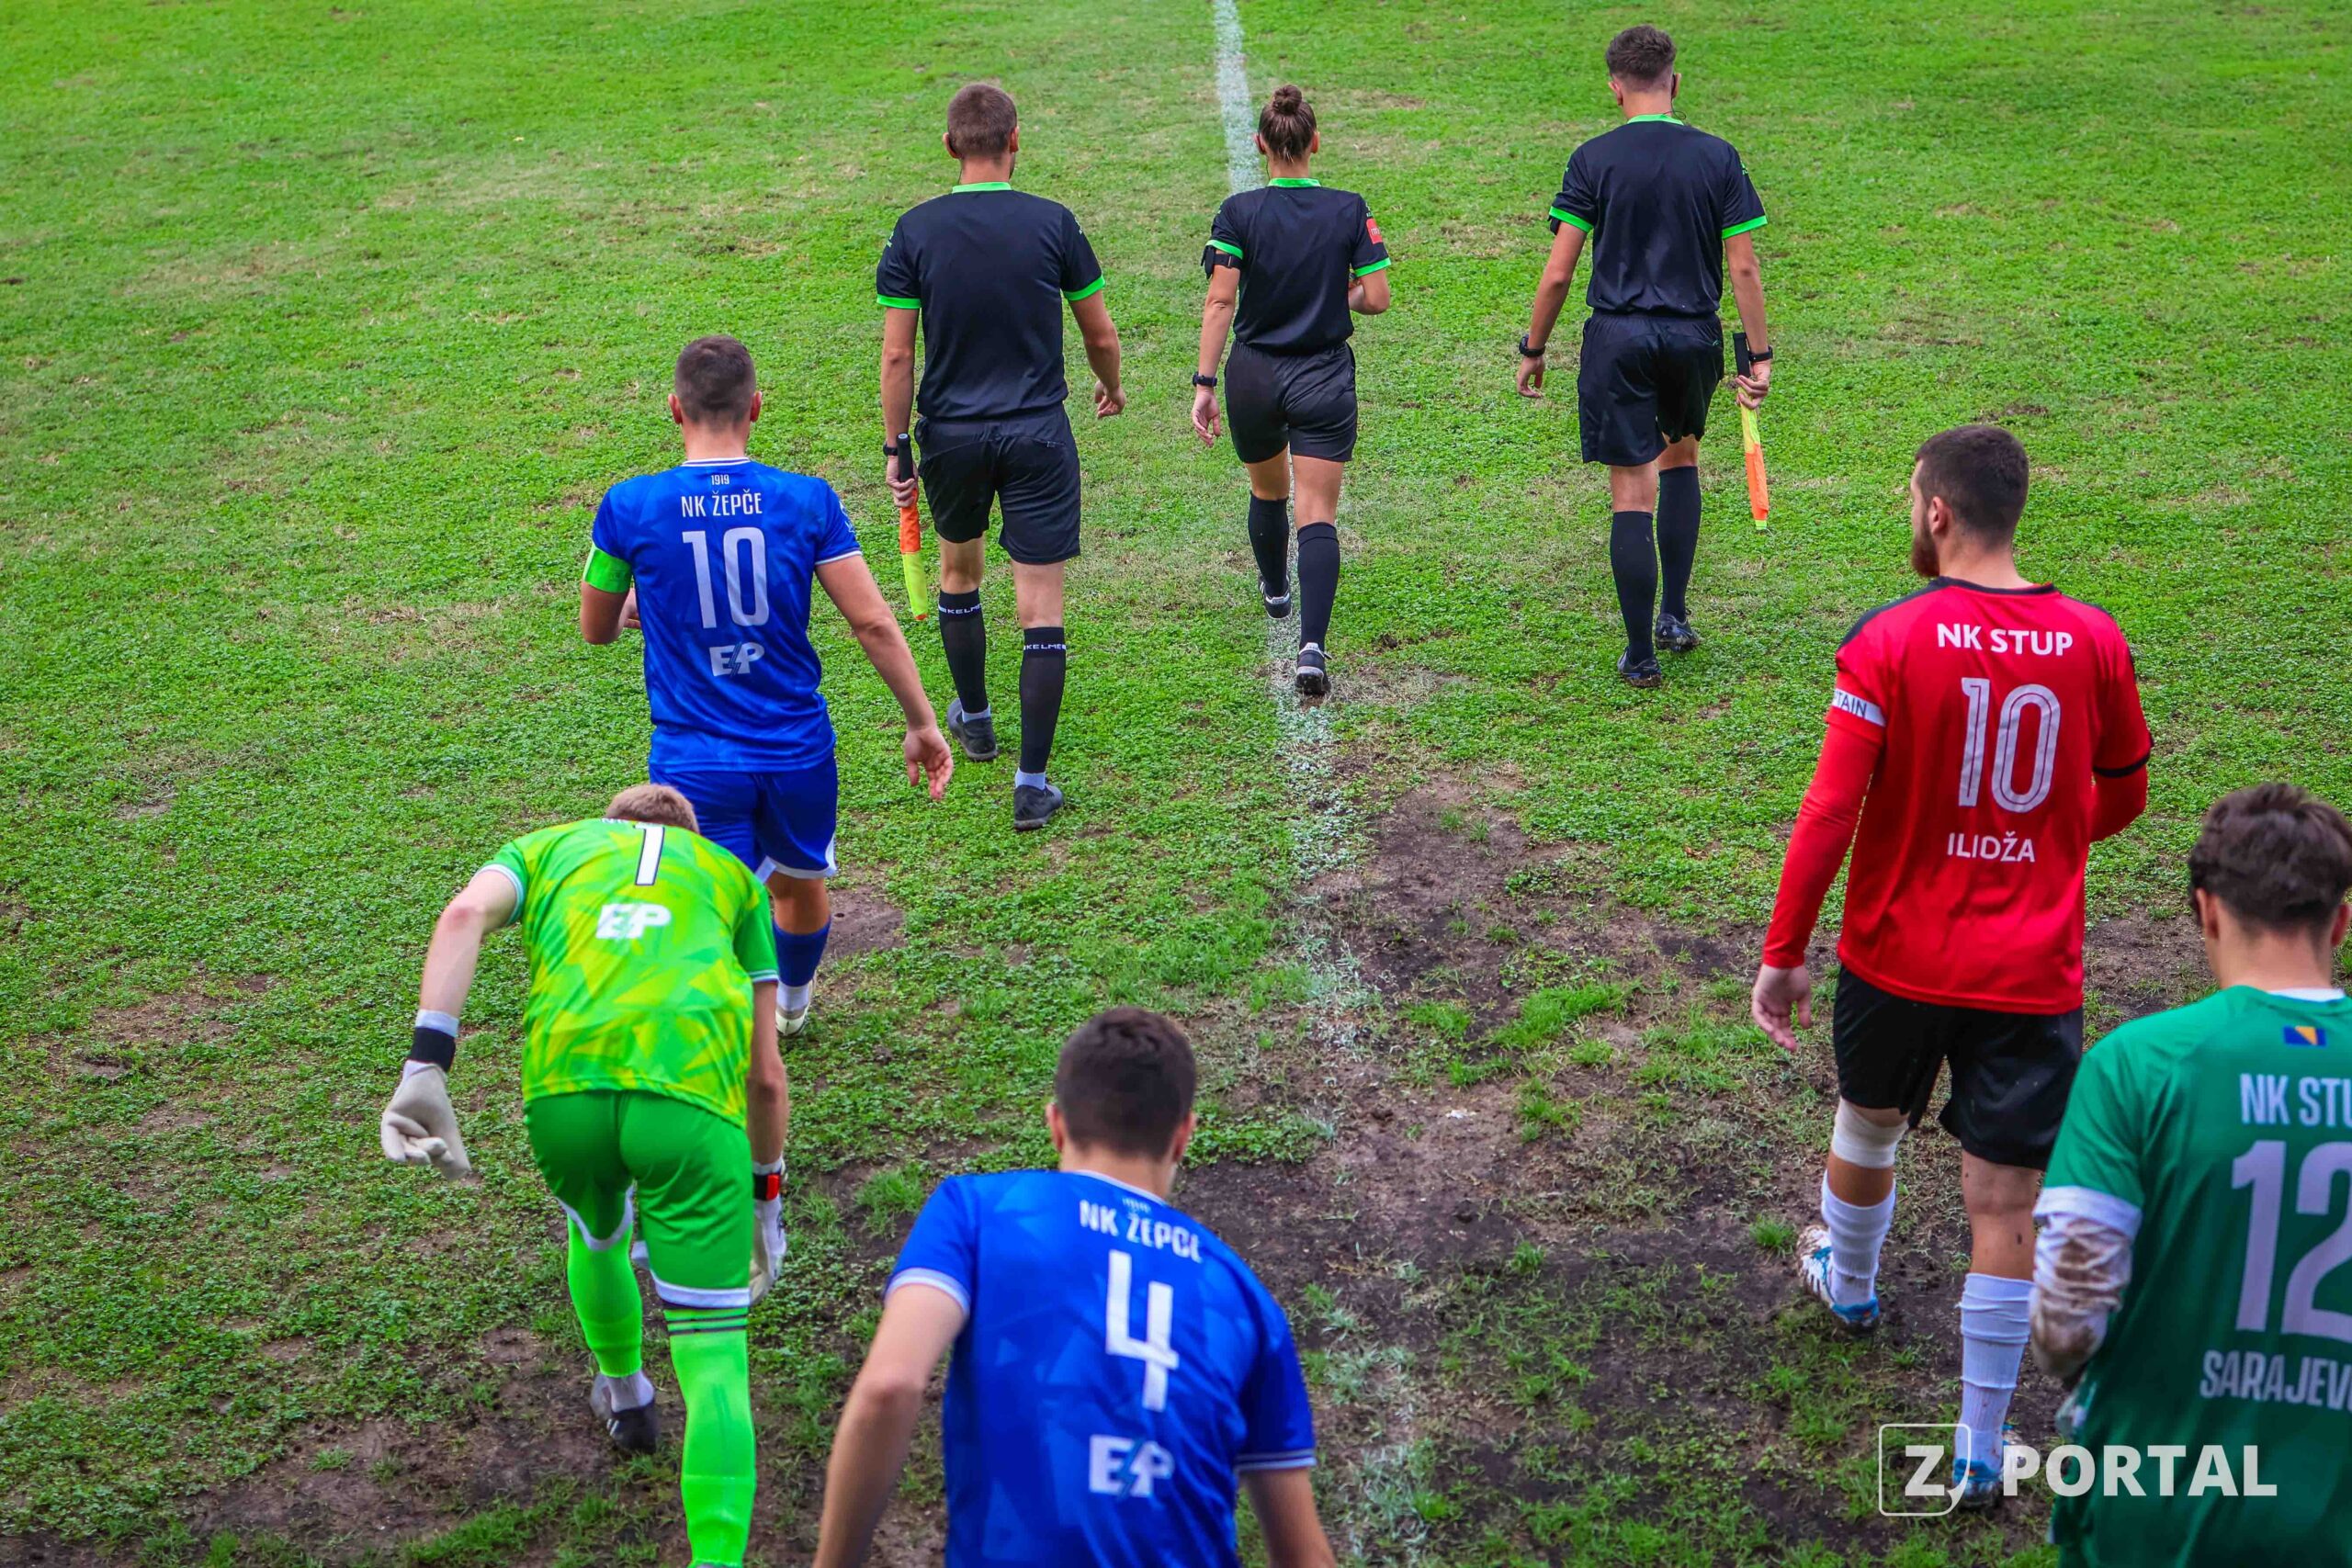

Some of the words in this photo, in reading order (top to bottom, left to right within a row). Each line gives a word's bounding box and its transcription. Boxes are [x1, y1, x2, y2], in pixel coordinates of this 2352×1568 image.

[681, 496, 706, 517] NK
[711, 489, 763, 516] ŽEPČE
[710, 474, 730, 486] 1919
[682, 526, 769, 628] 10
[708, 642, 765, 678] EP
[1937, 623, 1983, 650] NK
[1989, 628, 2073, 656] STUP
[1958, 677, 2061, 813] 10
[632, 822, 665, 886] 1
[1947, 830, 2036, 863] ILIDŽA
[594, 902, 672, 941] EP
[2239, 1072, 2290, 1125] NK
[1079, 1199, 1119, 1237] NK
[2232, 1140, 2352, 1343] 12
[1105, 1249, 1179, 1413] 4
[2199, 1349, 2352, 1413] SARAJEV
[1089, 1433, 1175, 1499] EP
